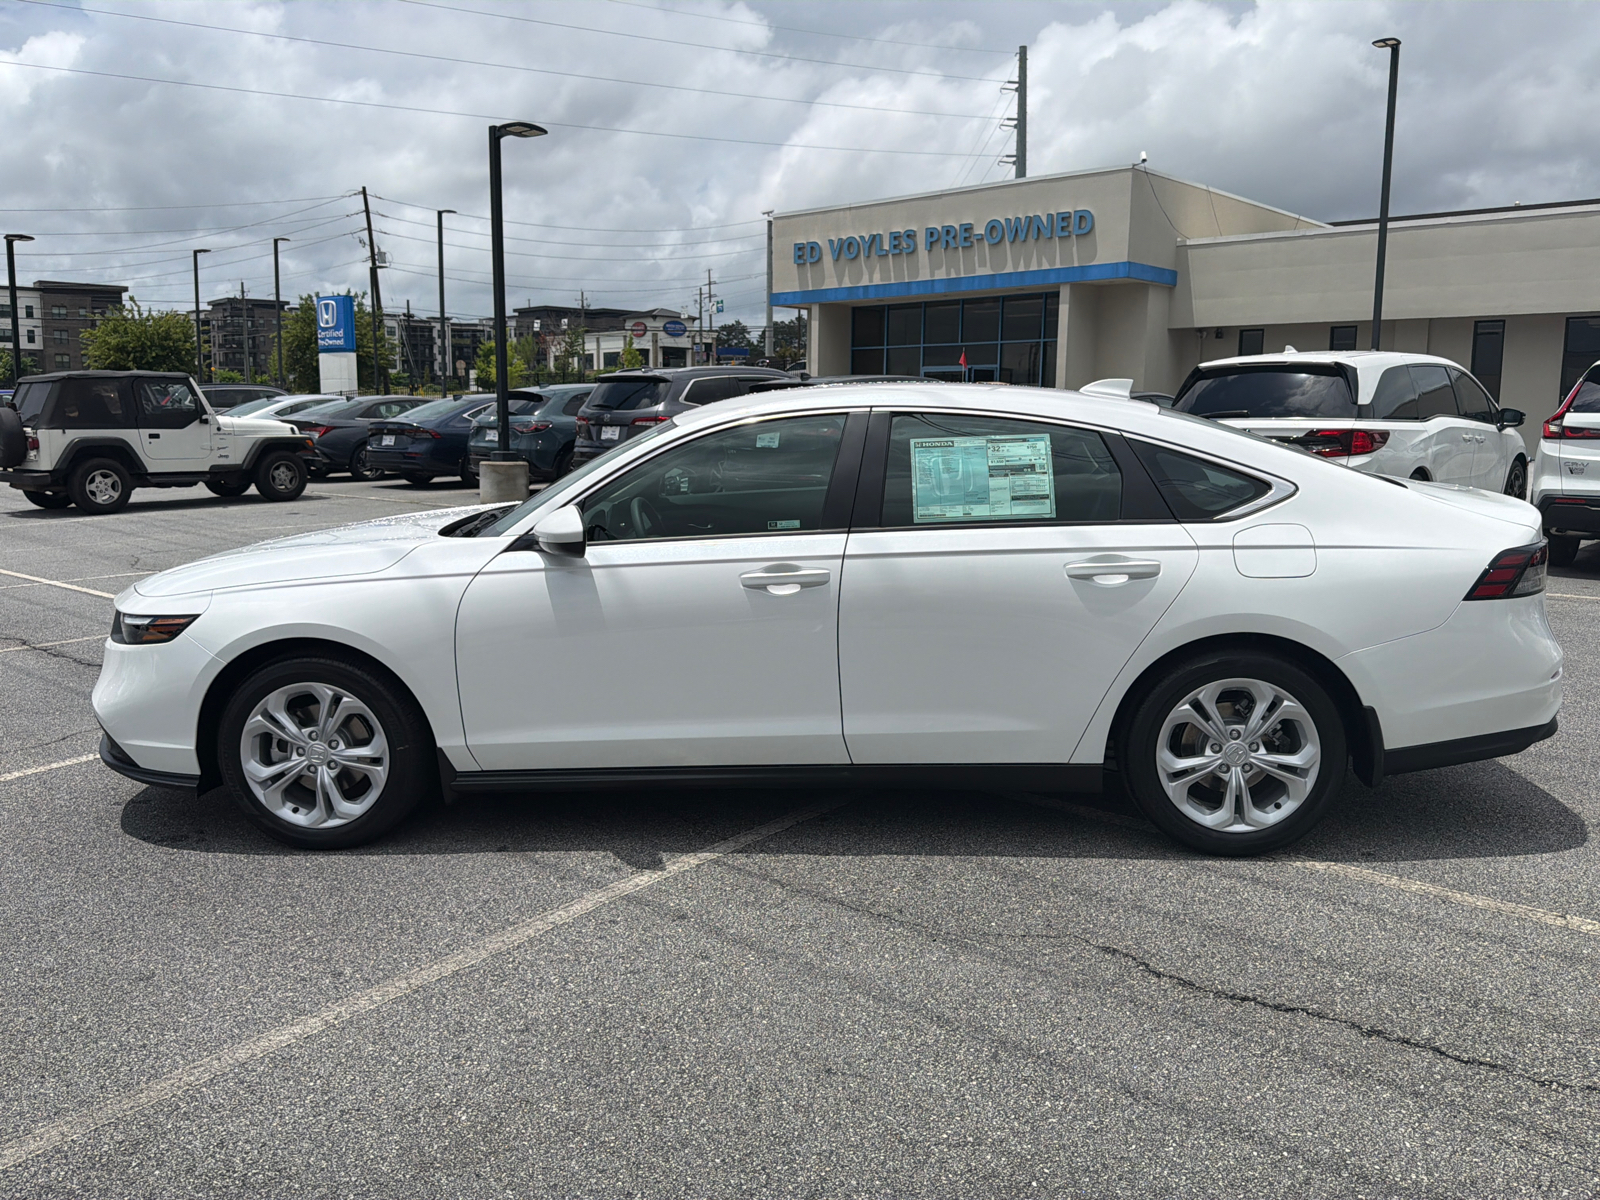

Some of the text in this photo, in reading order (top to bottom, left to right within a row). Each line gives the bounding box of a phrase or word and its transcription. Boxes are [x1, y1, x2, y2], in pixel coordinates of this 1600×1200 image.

[793, 209, 1094, 264] ED VOYLES PRE-OWNED
[318, 329, 343, 338] Certified
